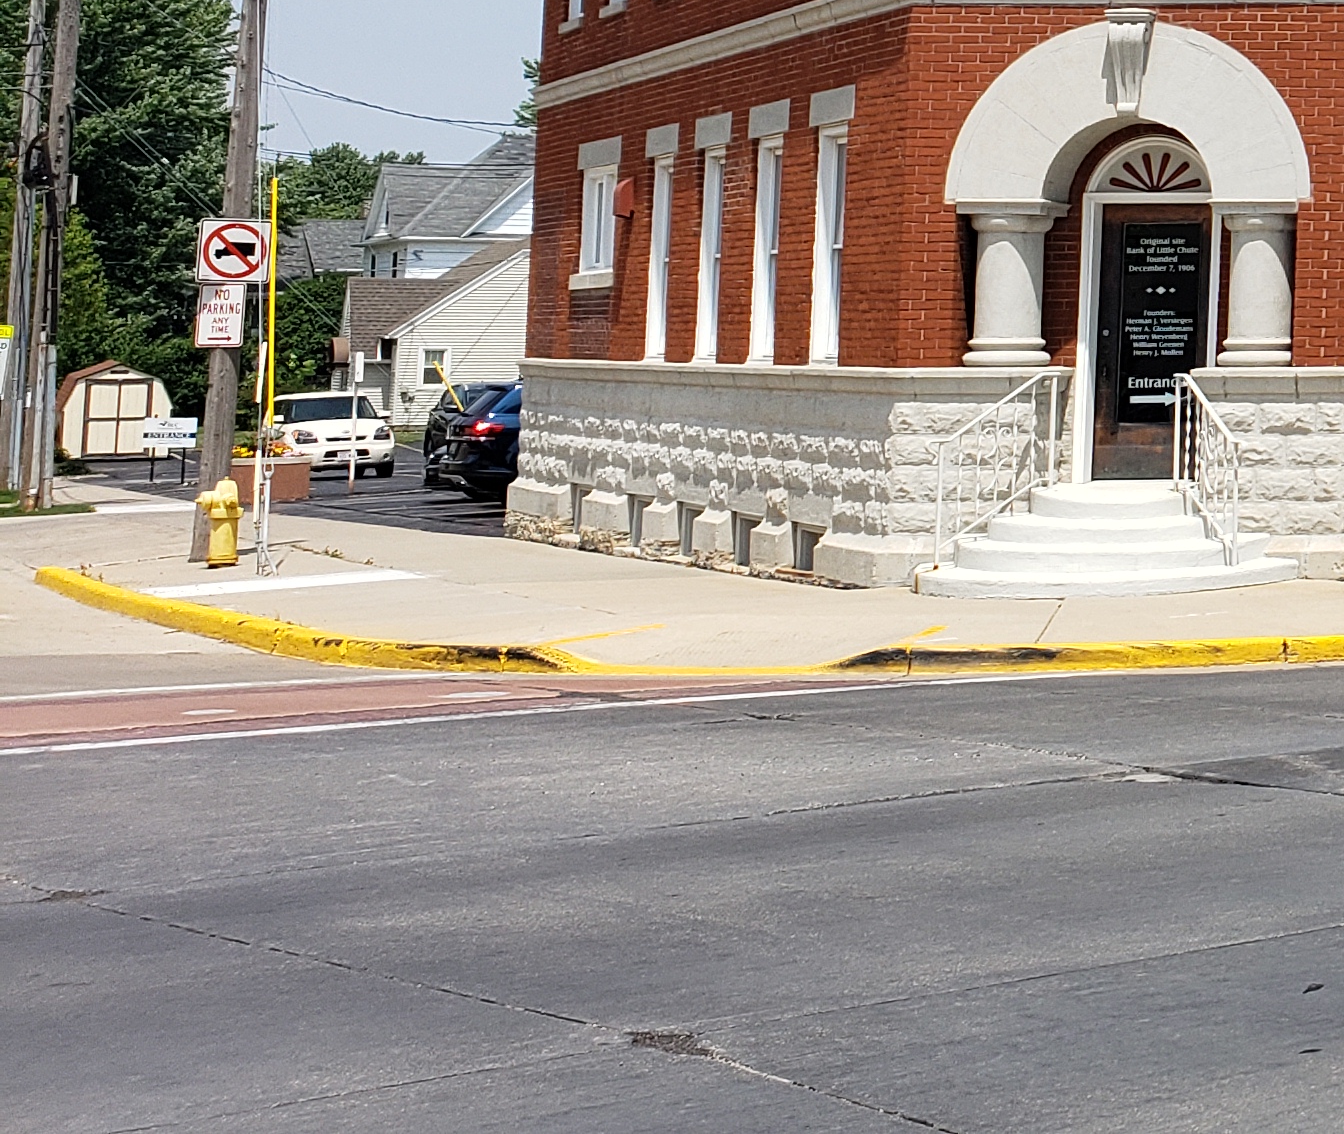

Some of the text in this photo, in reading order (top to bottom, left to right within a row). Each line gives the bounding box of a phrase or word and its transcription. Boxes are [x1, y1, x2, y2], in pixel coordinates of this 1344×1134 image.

[1140, 237, 1170, 246] Original
[214, 288, 230, 301] NO
[202, 302, 241, 315] PARKING
[211, 317, 229, 325] ANY
[211, 325, 229, 333] TIME
